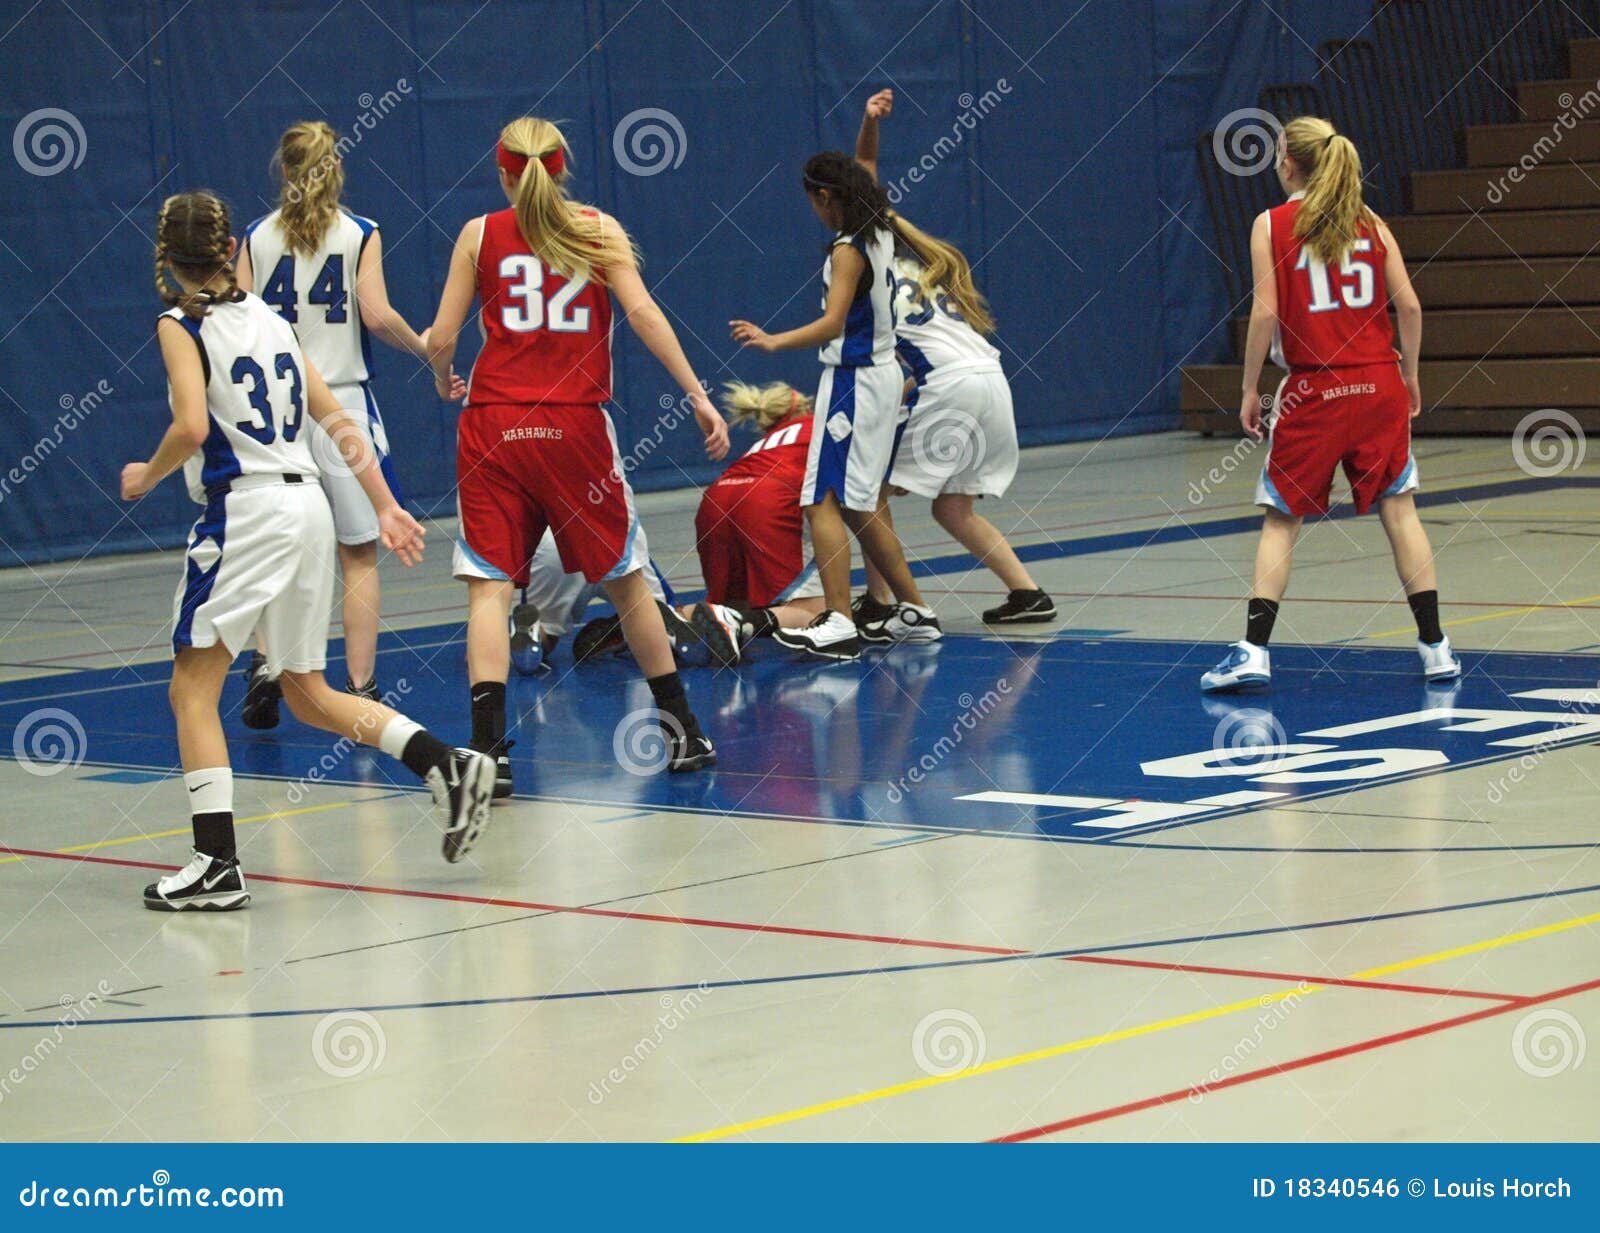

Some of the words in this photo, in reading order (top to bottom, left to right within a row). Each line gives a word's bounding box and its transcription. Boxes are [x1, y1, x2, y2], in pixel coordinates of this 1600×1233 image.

[262, 253, 348, 324] 44
[498, 253, 591, 333] 32
[1295, 238, 1375, 313] 15
[230, 352, 304, 446] 33
[1321, 383, 1376, 401] WARHAWKS
[502, 426, 563, 442] WARHAWKS
